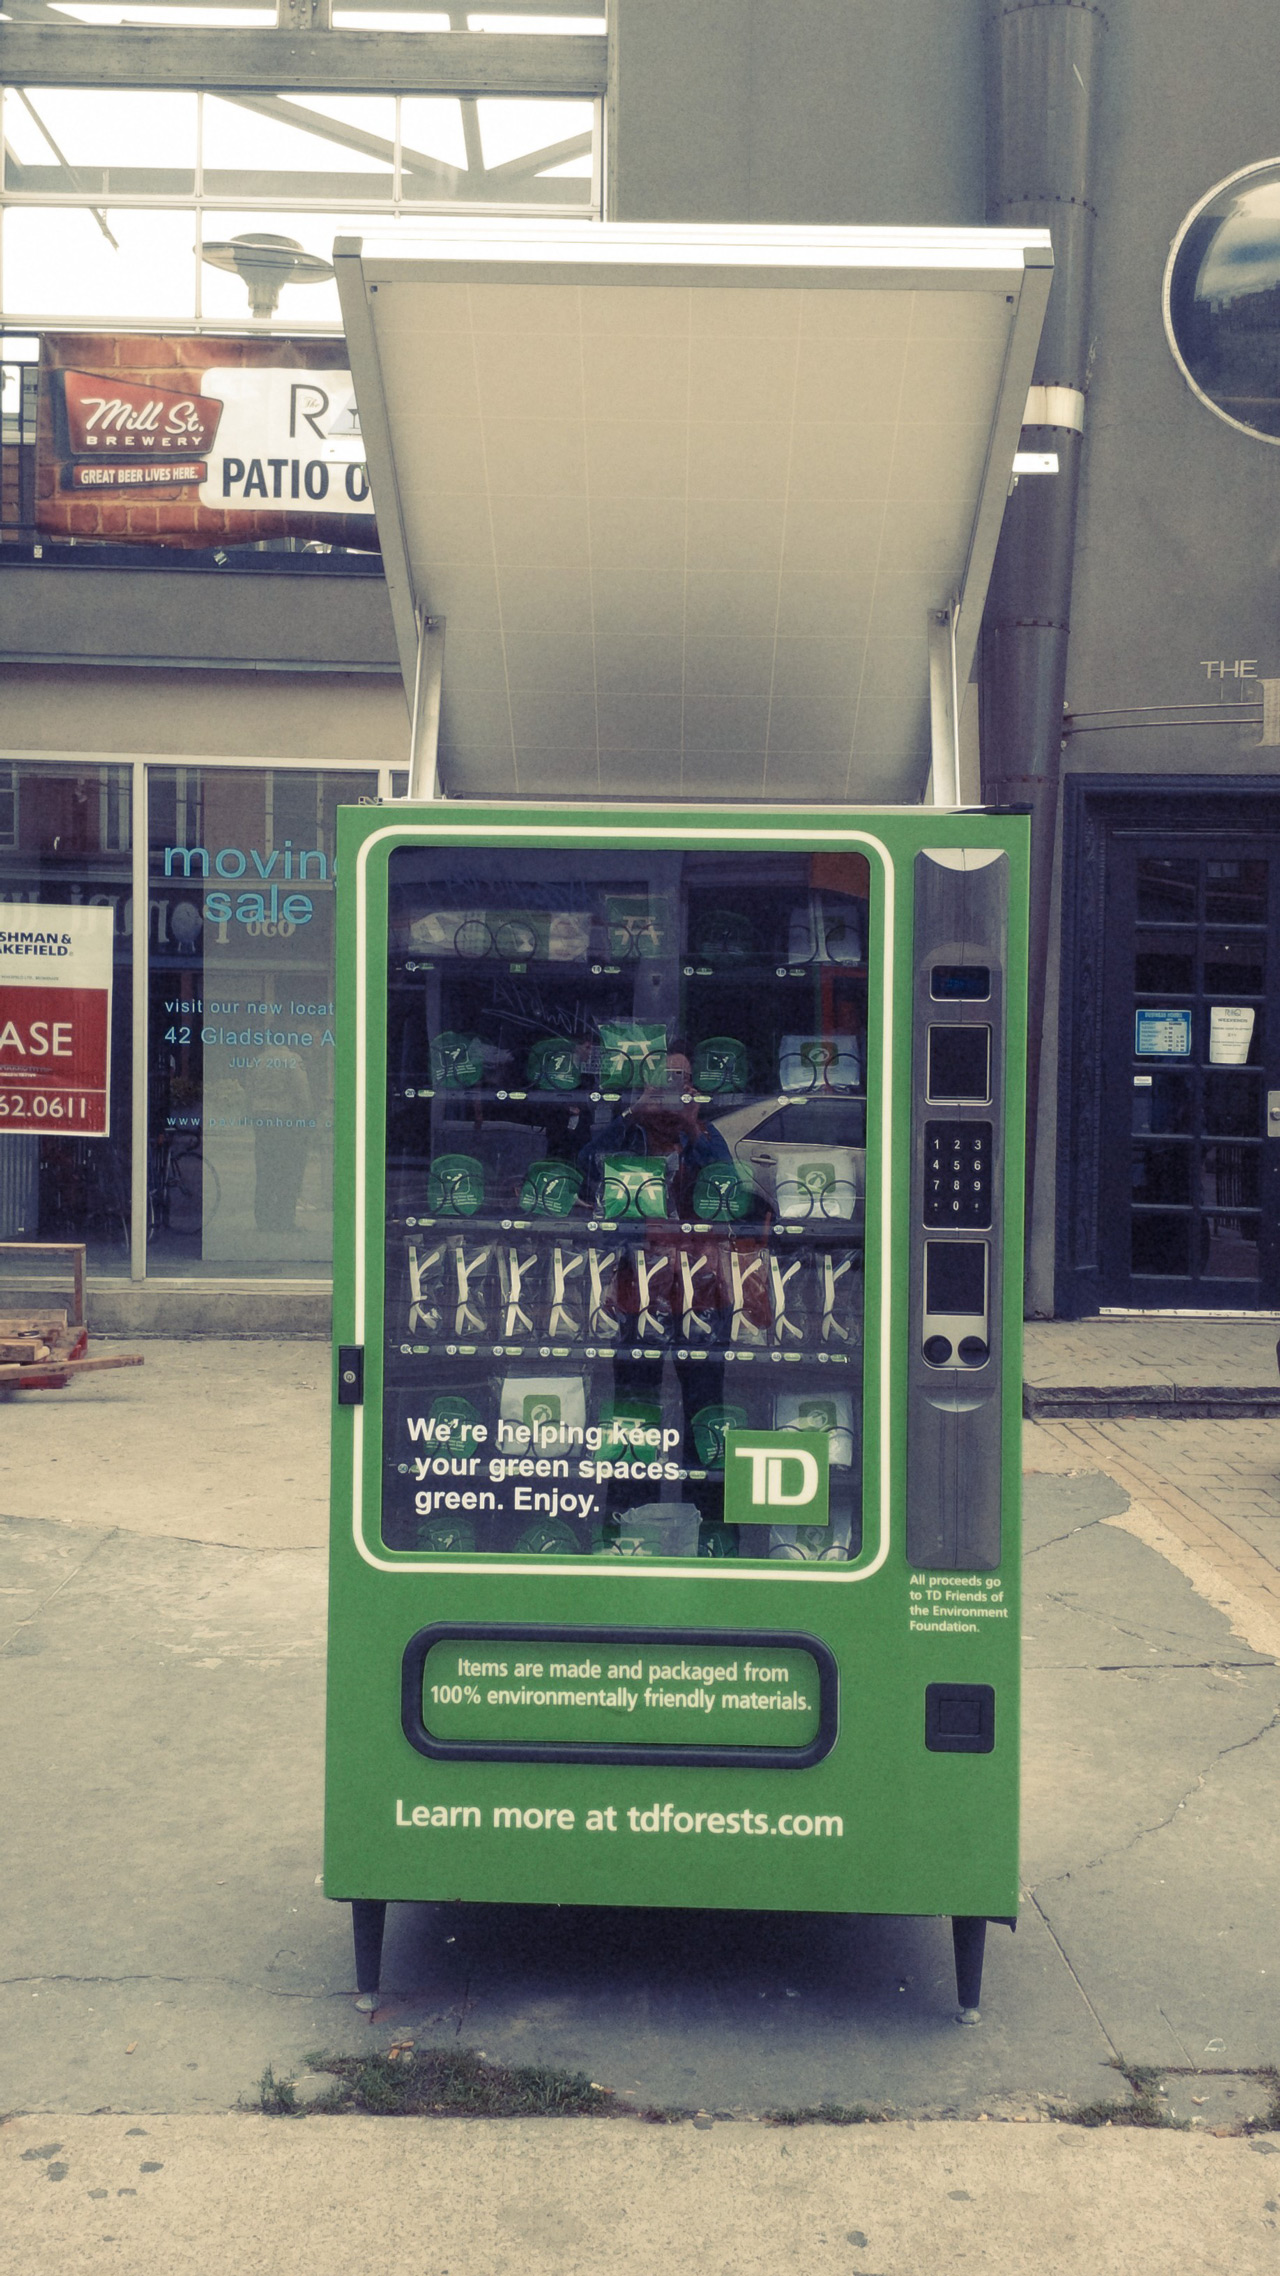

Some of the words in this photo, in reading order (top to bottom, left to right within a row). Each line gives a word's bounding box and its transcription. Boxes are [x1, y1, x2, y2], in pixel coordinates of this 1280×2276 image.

[80, 398, 164, 431] Mill
[165, 401, 204, 434] St.
[86, 436, 202, 446] BREWERY
[81, 469, 115, 484] GREAT
[118, 468, 143, 483] BEER
[145, 467, 171, 481] LIVES
[173, 466, 198, 480] HERE.
[222, 458, 329, 500] PATIO
[1200, 660, 1258, 679] THE
[164, 840, 338, 887] movin
[205, 884, 313, 924] sale
[0, 931, 58, 944] SHMAN
[61, 933, 72, 945] &
[165, 999, 203, 1013] visit
[210, 1002, 240, 1013] our
[248, 1003, 282, 1014] new
[0, 1021, 73, 1056] ASE
[165, 1027, 191, 1044] 42
[201, 1027, 313, 1046] Gladstone
[321, 1029, 336, 1046] A
[229, 1057, 261, 1068] JULY
[266, 1057, 297, 1069] 2012
[933, 1140, 940, 1150] 1
[954, 1140, 960, 1150] 2
[974, 1140, 981, 1150] 3
[933, 1160, 939, 1170] 4
[953, 1160, 960, 1170] 5
[974, 1160, 981, 1171] 6
[933, 1180, 939, 1190] 7
[953, 1180, 960, 1190] 8
[974, 1180, 981, 1191] 9
[953, 1201, 959, 1211] 0
[498, 1419, 602, 1450] helping
[612, 1421, 680, 1452] keep
[415, 1457, 481, 1481] your
[489, 1458, 569, 1482] green
[578, 1460, 679, 1484] spaces
[735, 1447, 819, 1506] TD
[415, 1490, 504, 1515] green.
[514, 1487, 600, 1518] Enjoy.
[909, 1574, 925, 1585] All
[929, 1575, 982, 1588] proceeds
[985, 1578, 1001, 1589] go
[909, 1590, 922, 1600] to
[925, 1590, 942, 1600] TD
[946, 1590, 987, 1602] Friends
[991, 1591, 1004, 1602] of
[909, 1605, 929, 1615] the
[933, 1605, 1008, 1618] Environment
[909, 1620, 980, 1632] Foundation.
[458, 1658, 508, 1677] Items
[514, 1663, 543, 1678] are
[549, 1659, 602, 1679] made
[607, 1660, 643, 1680] and
[648, 1661, 738, 1685] packaged
[743, 1662, 789, 1682] from
[430, 1685, 481, 1704] 100%
[486, 1686, 638, 1711] environmentally
[644, 1688, 716, 1713] friendly
[721, 1691, 812, 1711] materials.
[396, 1799, 482, 1828] Learn
[493, 1806, 575, 1831] more
[585, 1806, 618, 1831] at
[627, 1803, 844, 1837] tdforests.com
